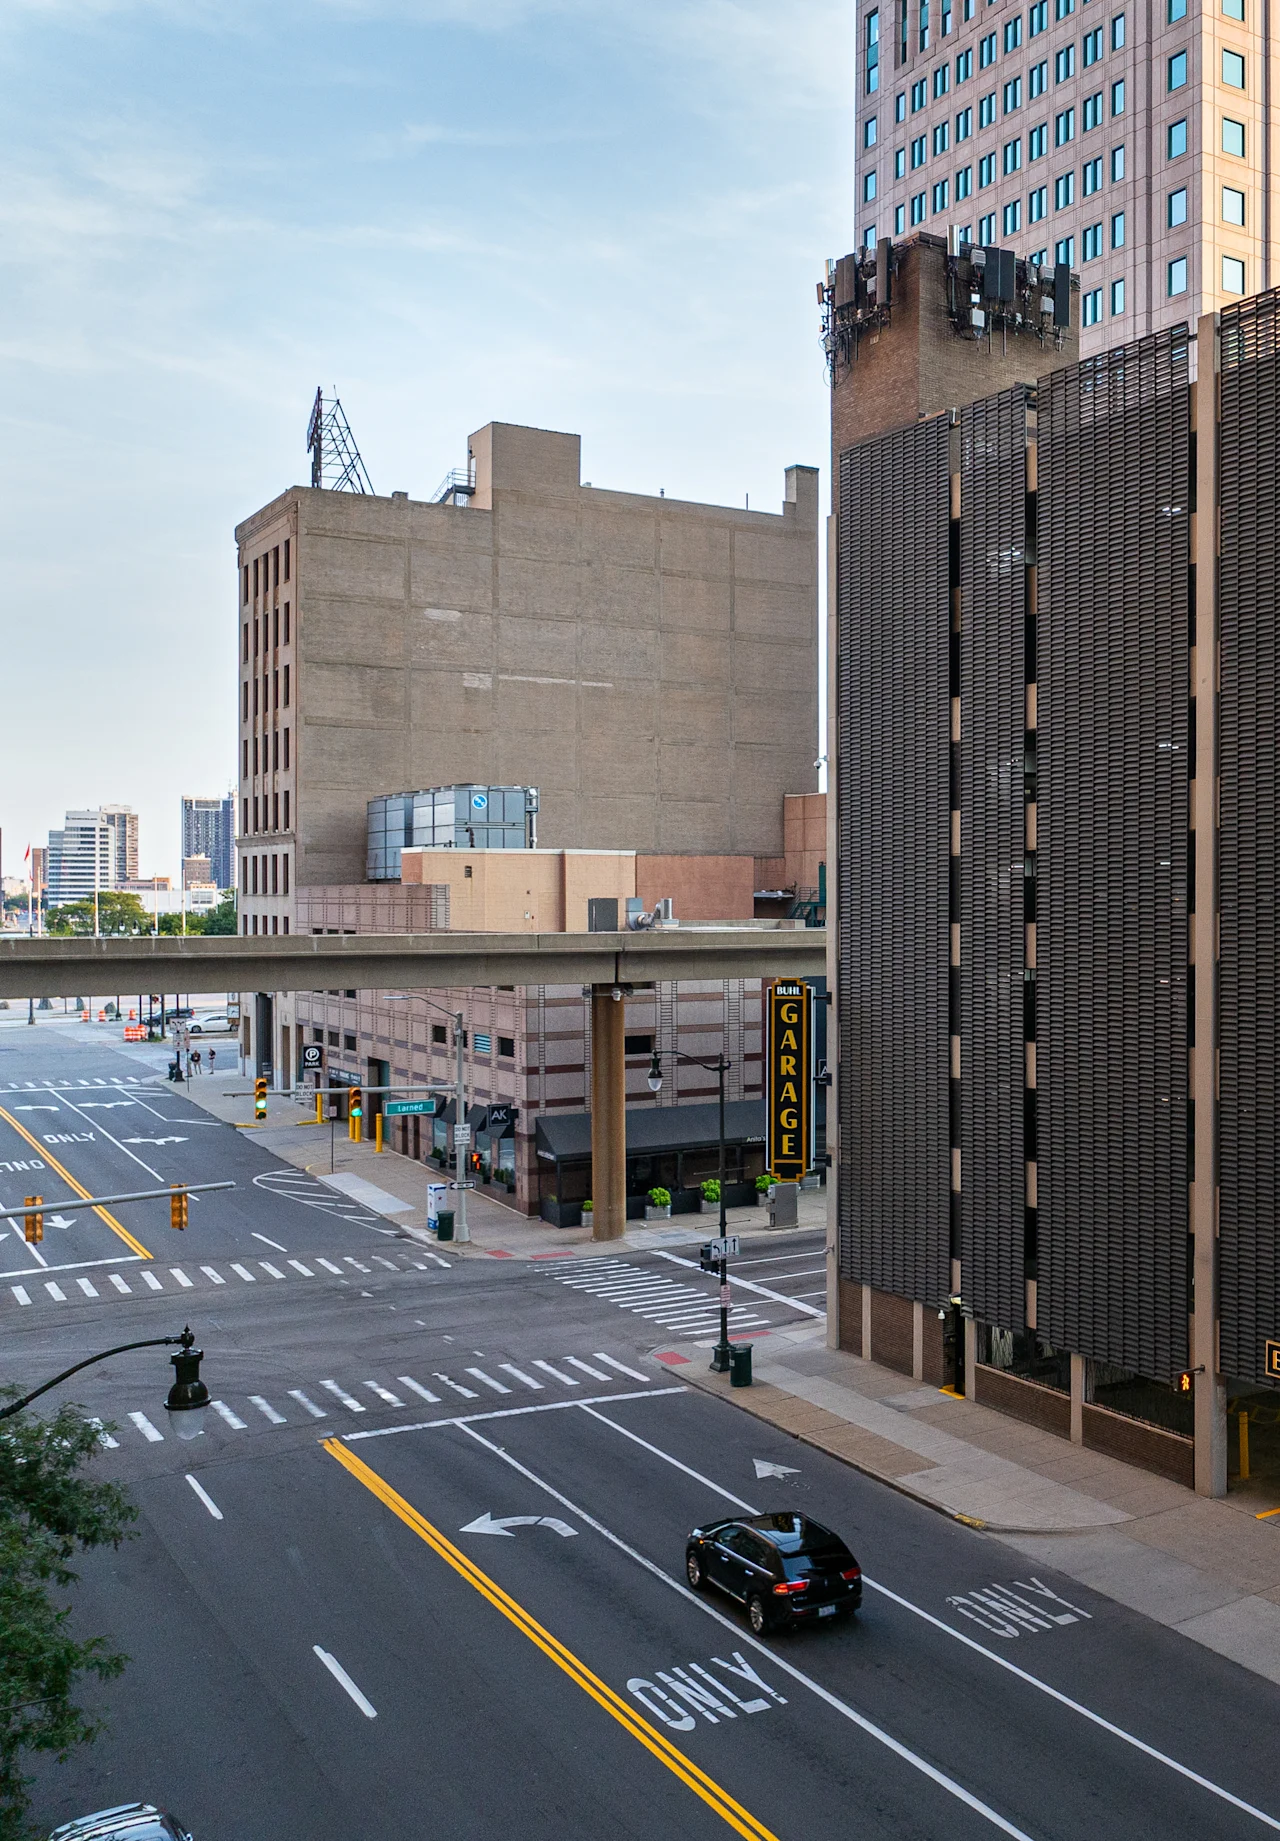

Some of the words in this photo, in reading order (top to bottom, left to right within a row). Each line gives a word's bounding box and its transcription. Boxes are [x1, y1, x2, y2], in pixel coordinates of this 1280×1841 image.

[776, 986, 801, 996] BUHL
[780, 1003, 798, 1155] GARAGE
[397, 1103, 424, 1112] Larned
[491, 1109, 507, 1120] AK
[43, 1132, 96, 1143] ONLY
[0, 1160, 45, 1173] ONL
[946, 1577, 1093, 1638] ONLY
[627, 1652, 788, 1731] ONLY
